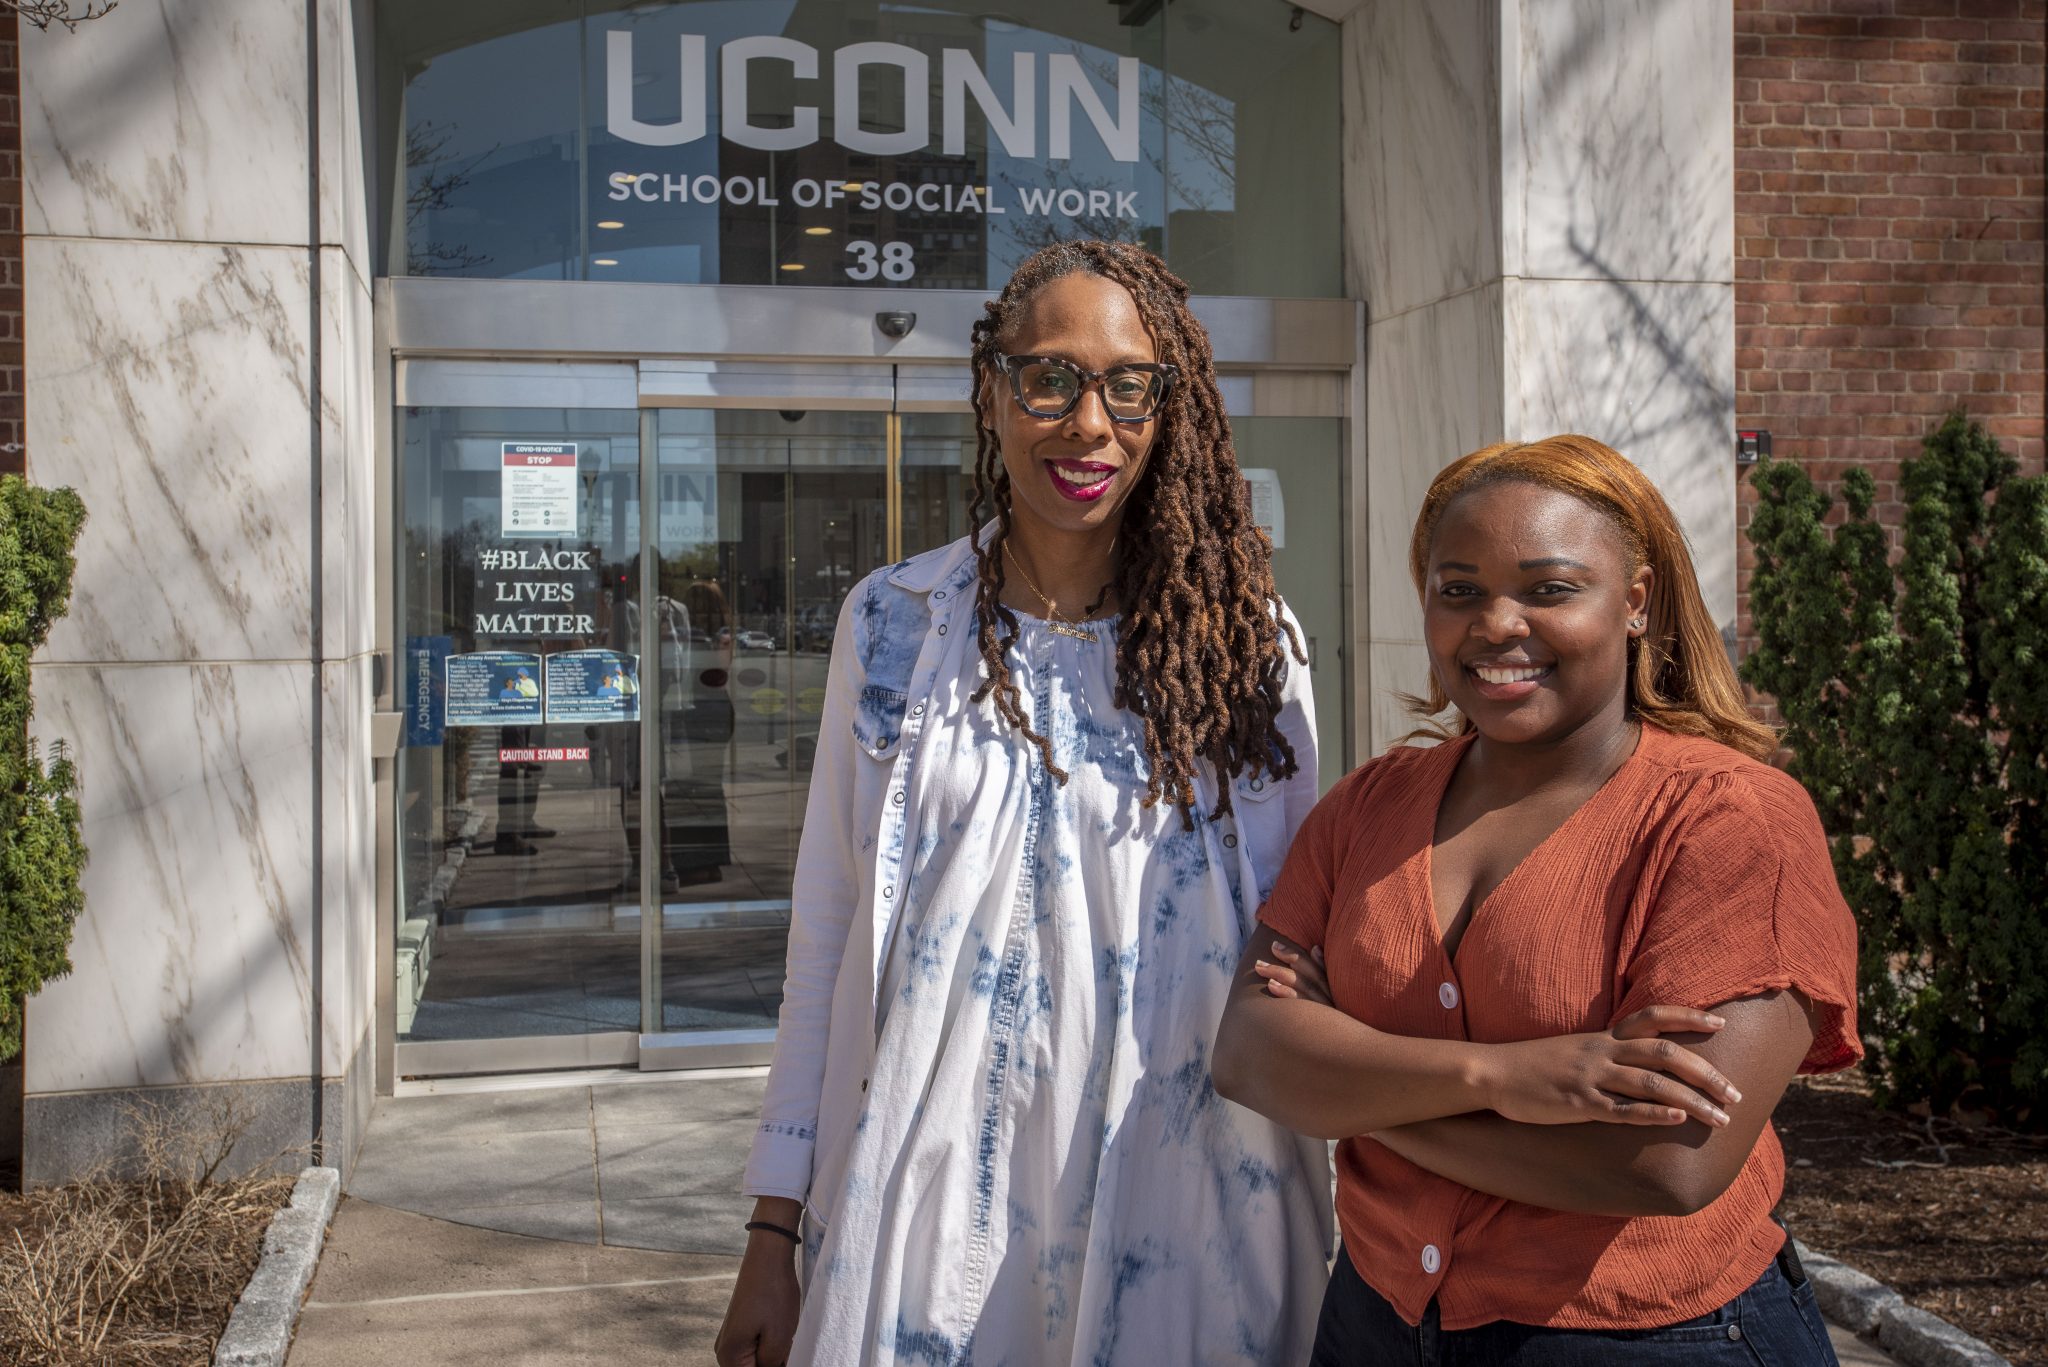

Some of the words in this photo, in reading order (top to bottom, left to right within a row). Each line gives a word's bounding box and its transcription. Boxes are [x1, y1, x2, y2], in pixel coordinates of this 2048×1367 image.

[606, 30, 1140, 162] UCONN
[607, 172, 779, 206] SCHOOL
[792, 178, 846, 208] OF
[859, 181, 1005, 214] SOCIAL
[1018, 187, 1139, 219] WORK
[844, 239, 916, 281] 38
[527, 456, 552, 464] STOP
[482, 549, 591, 570] #BLACK
[495, 582, 575, 602] LIVES
[475, 613, 594, 634] MATTER
[418, 649, 430, 730] EMERGENCY
[501, 749, 534, 761] CAUTION
[537, 748, 563, 760] STAND
[566, 747, 587, 760] BACK
